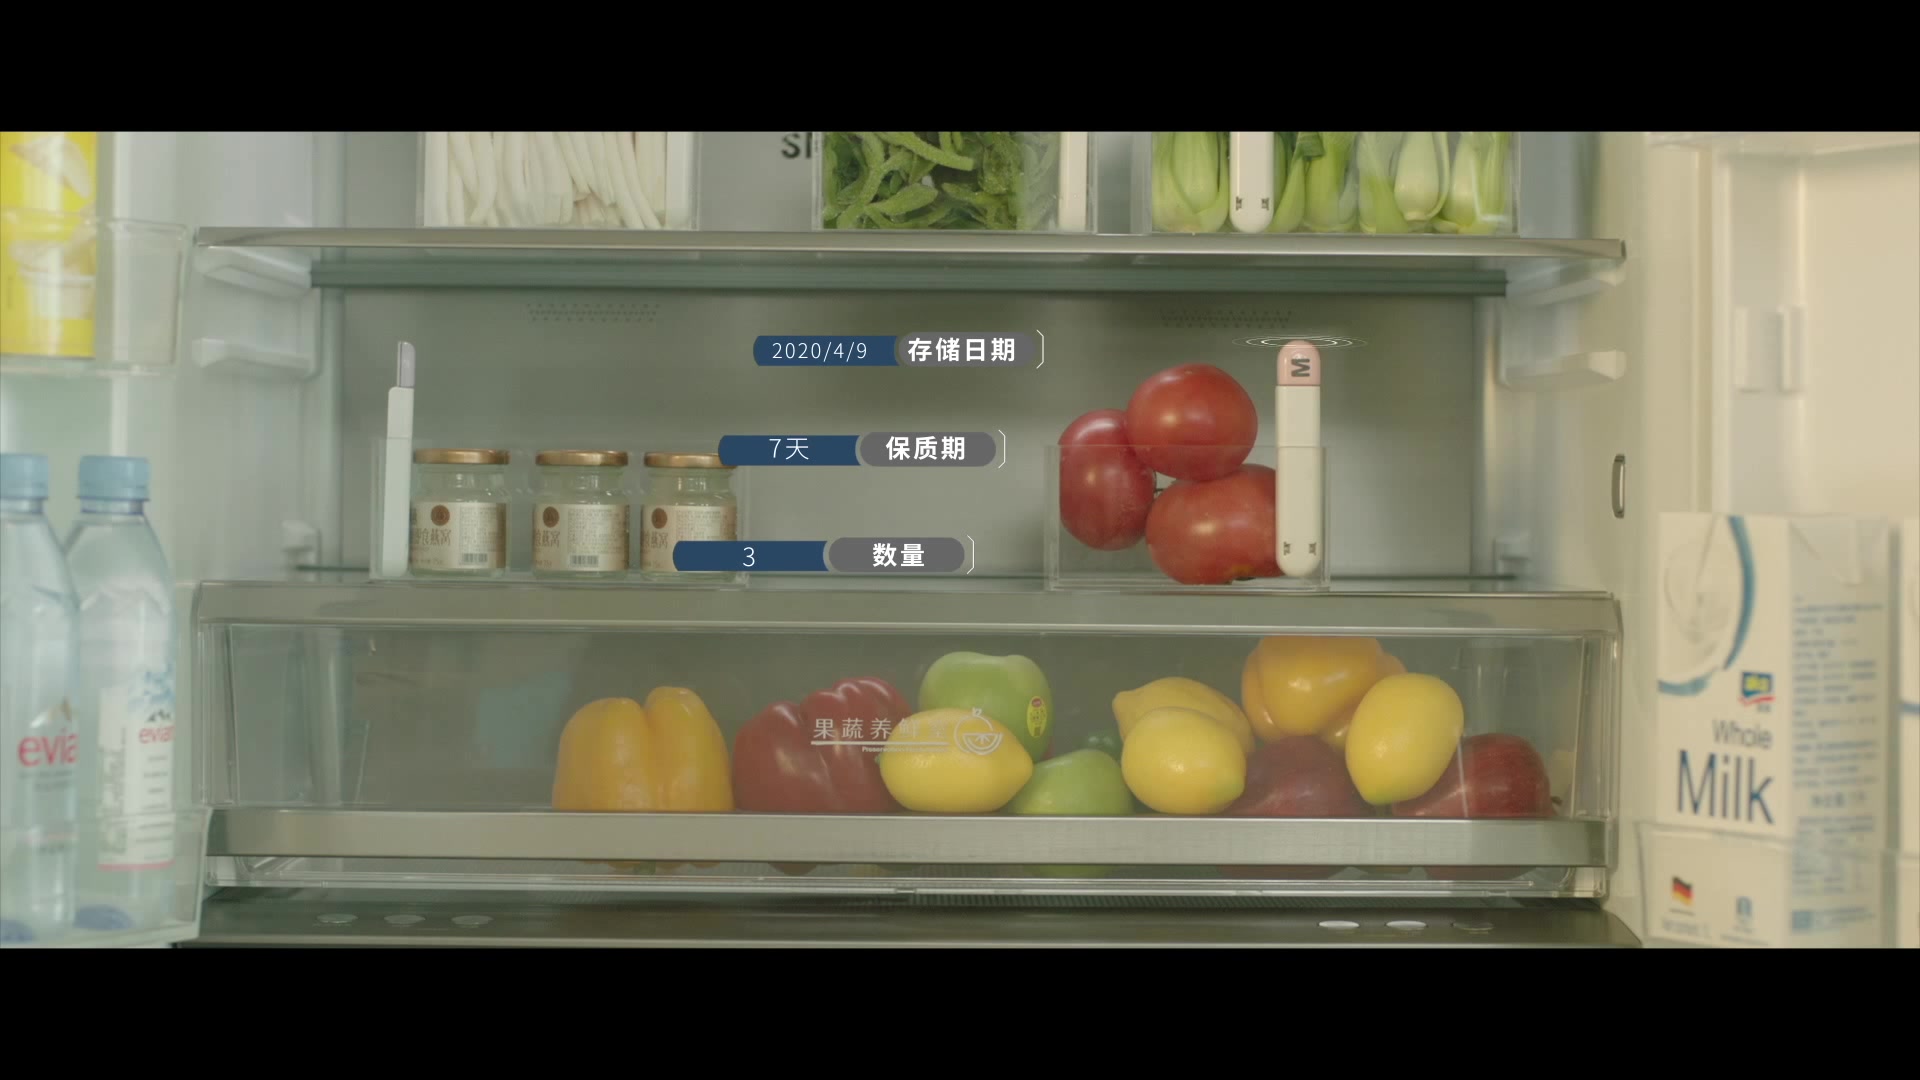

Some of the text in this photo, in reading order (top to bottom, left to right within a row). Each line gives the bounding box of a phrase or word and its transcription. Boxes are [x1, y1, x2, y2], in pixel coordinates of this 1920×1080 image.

[1291, 358, 1310, 377] M
[1711, 718, 1773, 751] Whole
[1677, 749, 1776, 824] Milk
